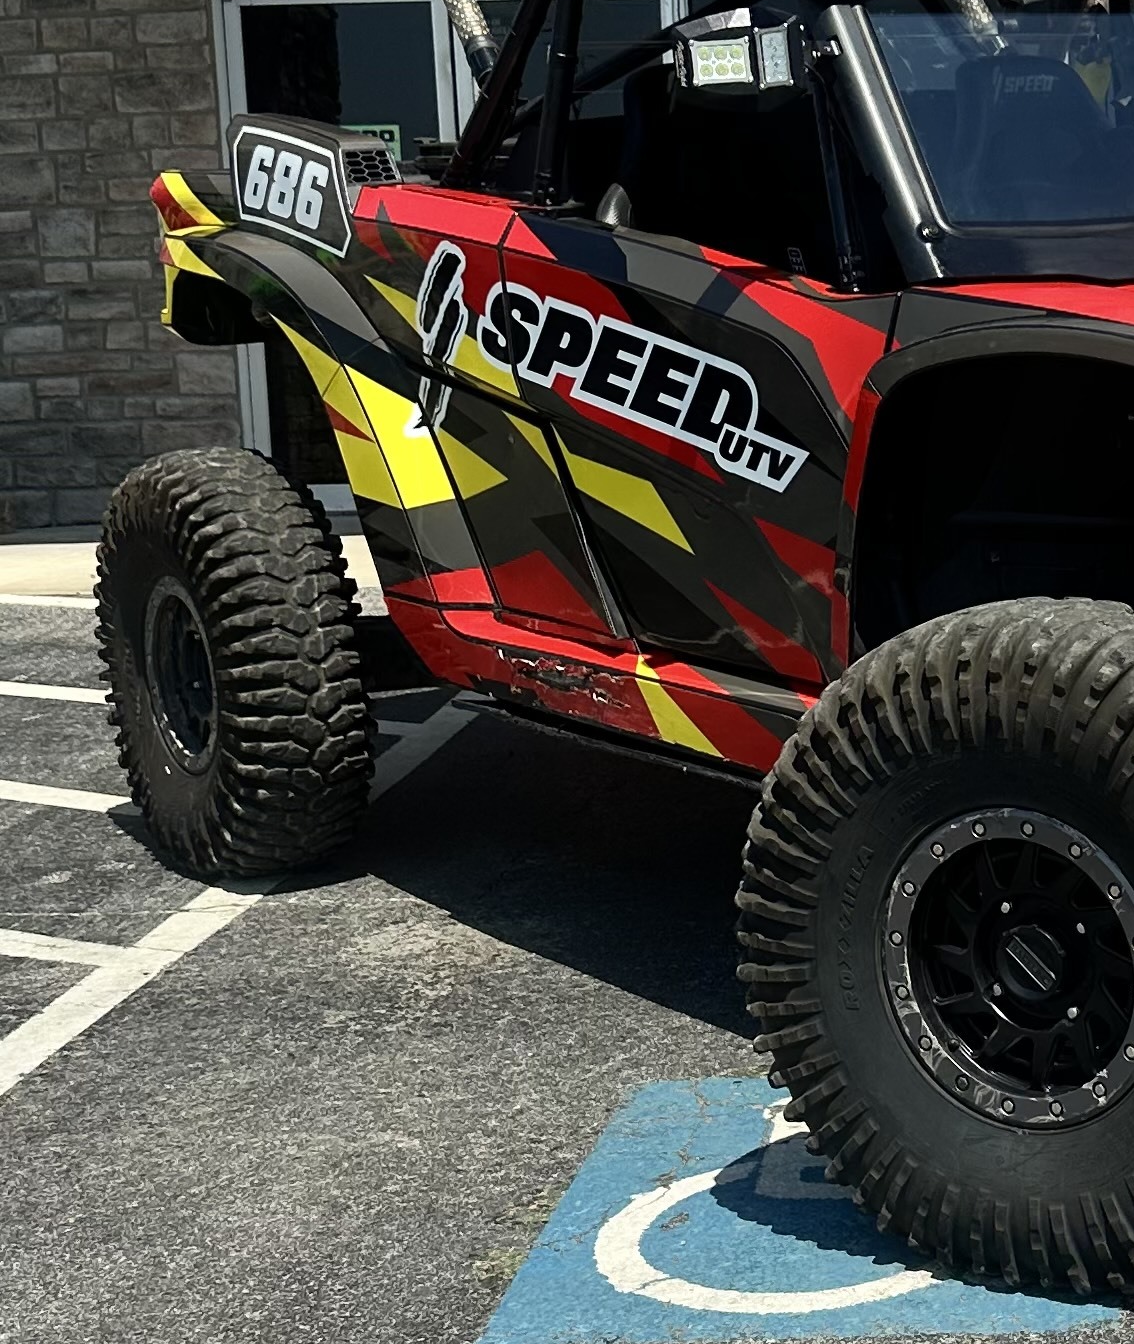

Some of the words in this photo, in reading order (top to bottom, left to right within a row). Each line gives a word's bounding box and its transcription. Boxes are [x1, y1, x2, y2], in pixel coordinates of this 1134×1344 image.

[243, 144, 330, 230] 686
[479, 289, 756, 444] SPEED
[718, 428, 797, 482] UTV
